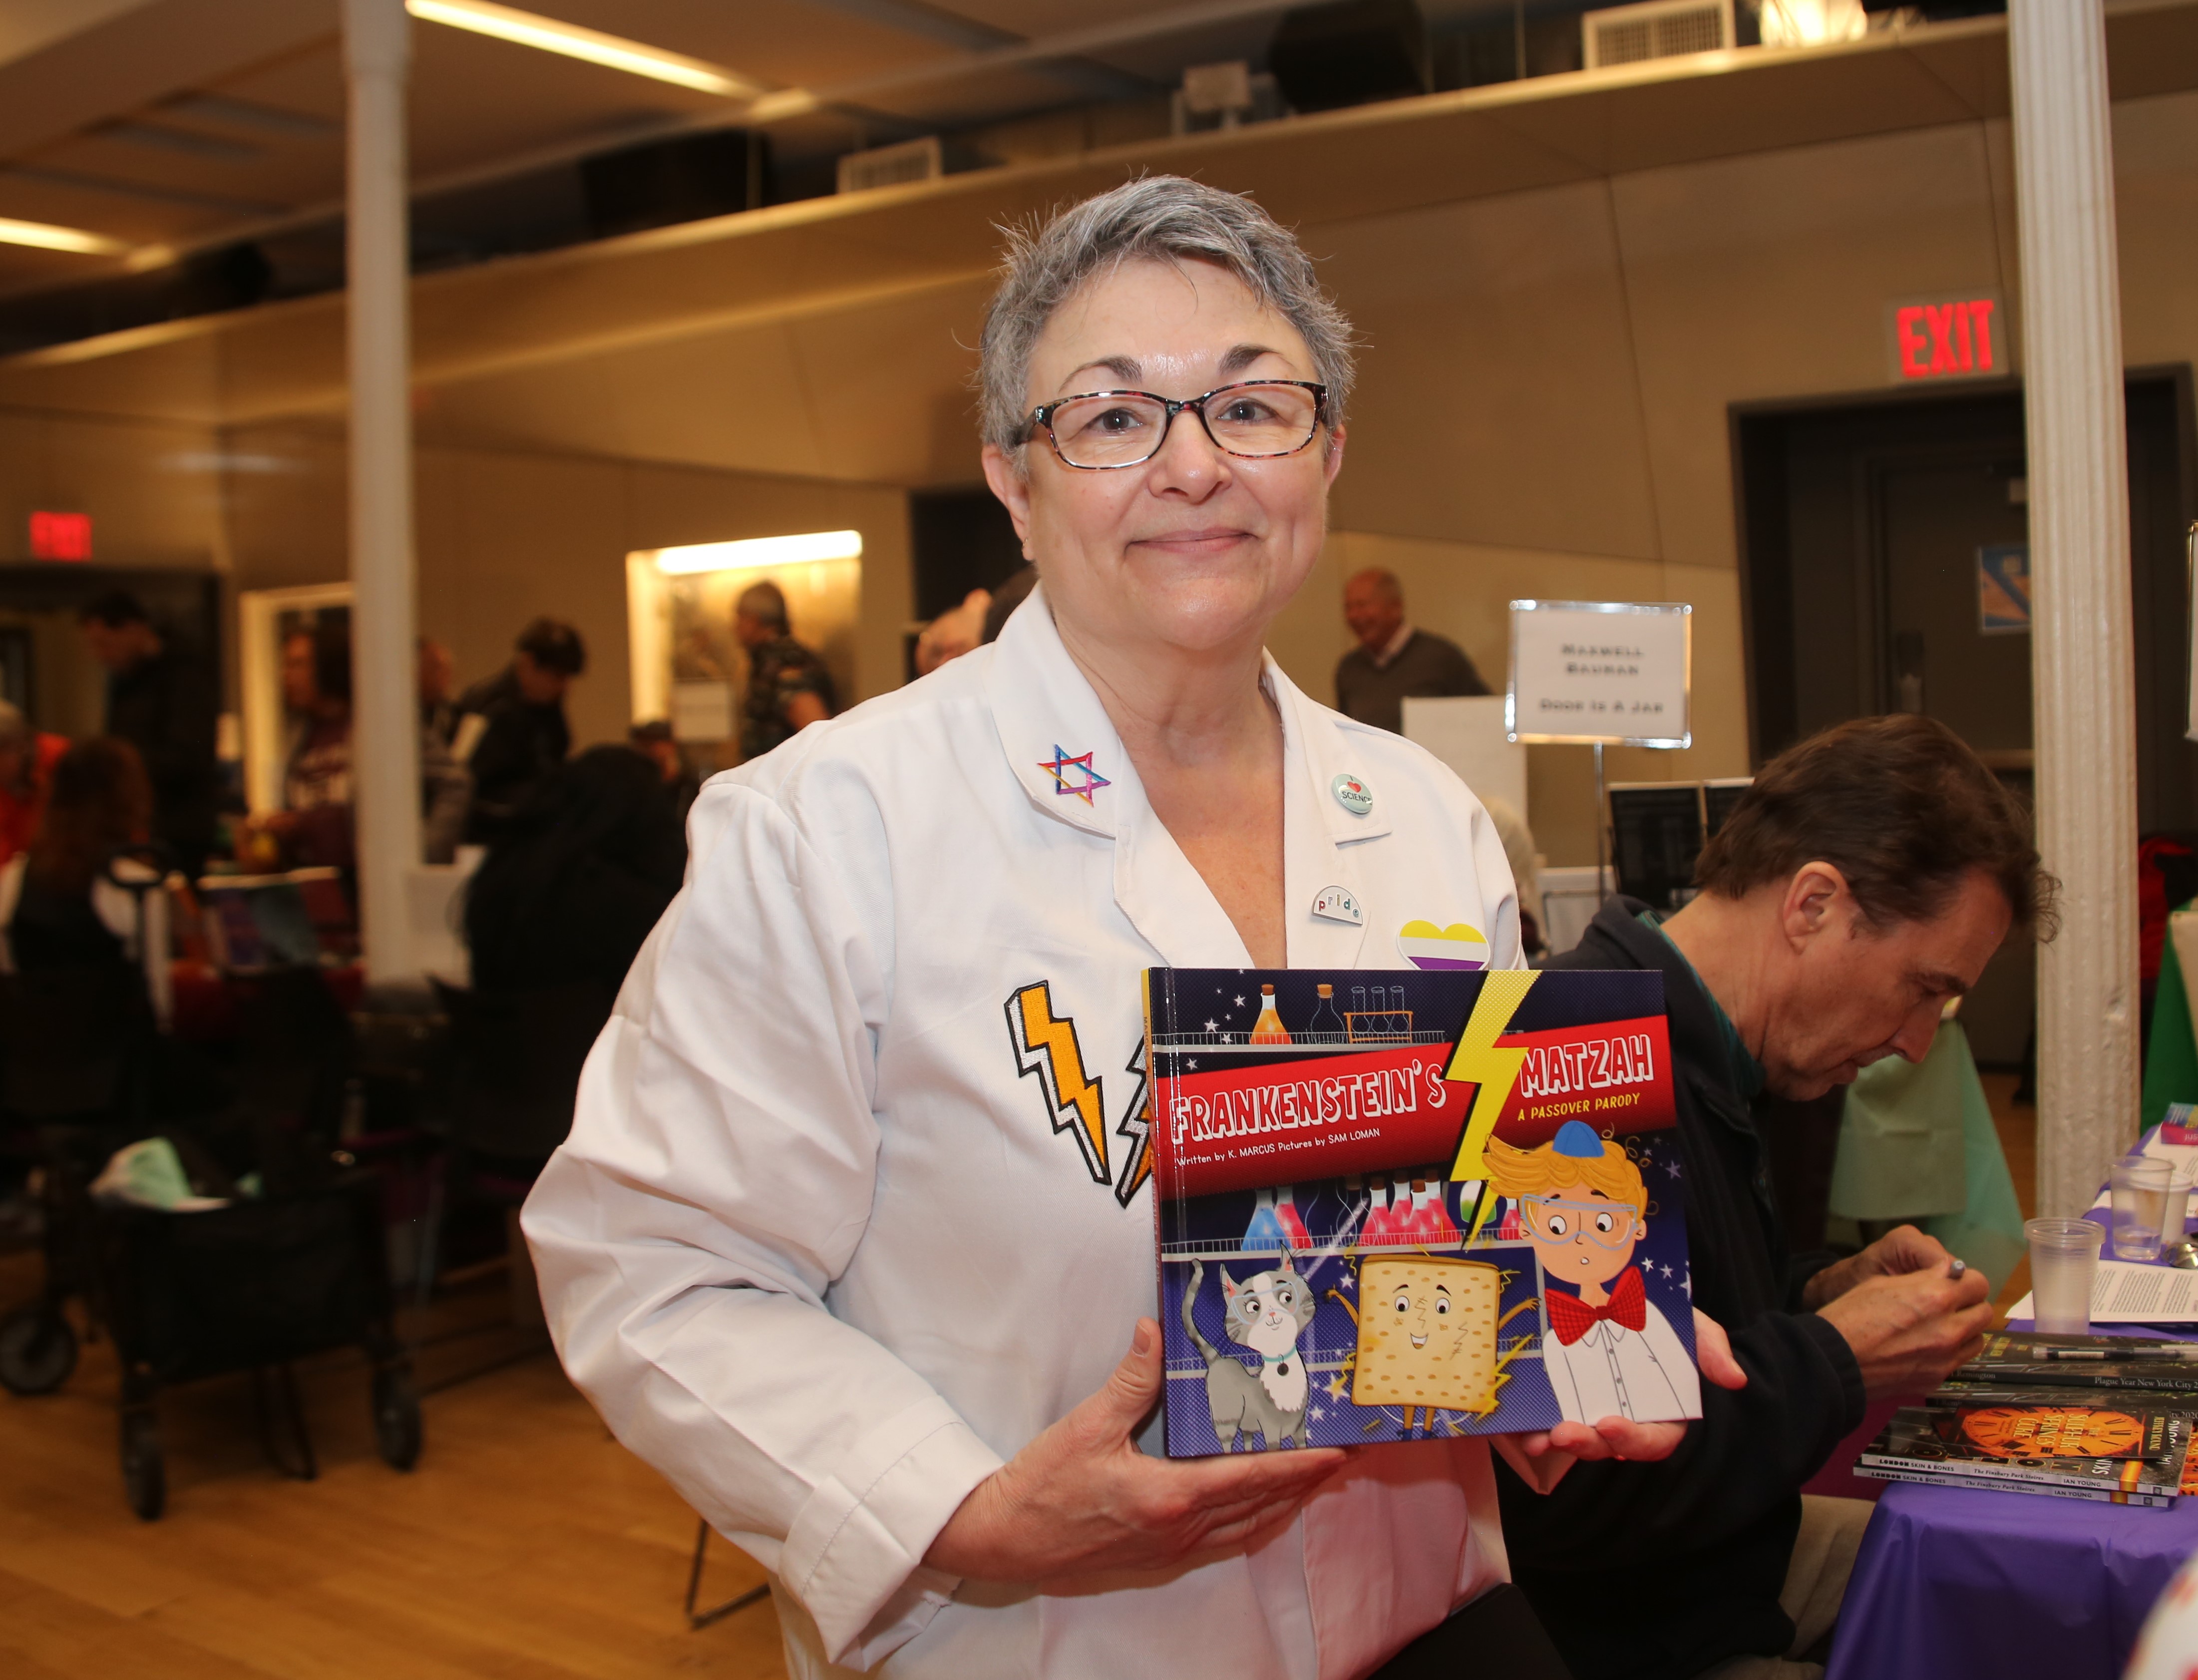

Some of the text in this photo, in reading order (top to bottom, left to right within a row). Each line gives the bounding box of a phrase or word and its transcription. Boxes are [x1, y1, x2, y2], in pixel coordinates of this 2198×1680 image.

[1896, 299, 1994, 378] EXIT
[1613, 700, 1625, 713] A
[1319, 894, 1359, 918] pride
[1519, 1034, 1654, 1098] MATZAH
[1169, 1058, 1447, 1145] FRANKENSTEIN'S
[1517, 1092, 1640, 1121] A PASSOVER PARODY
[1176, 1127, 1381, 1167] Written by K. MARCUS Pictures by SAM LOMAN
[2095, 1376, 2119, 1386] Plague
[2175, 1381, 2192, 1390] City
[2013, 1416, 2040, 1439] CURE
[2035, 1413, 2065, 1446] SPRINGS
[2059, 1413, 2090, 1449] SULPHUR
[1871, 1471, 1901, 1480] LONDON
[1879, 1458, 1909, 1467] LONDON
